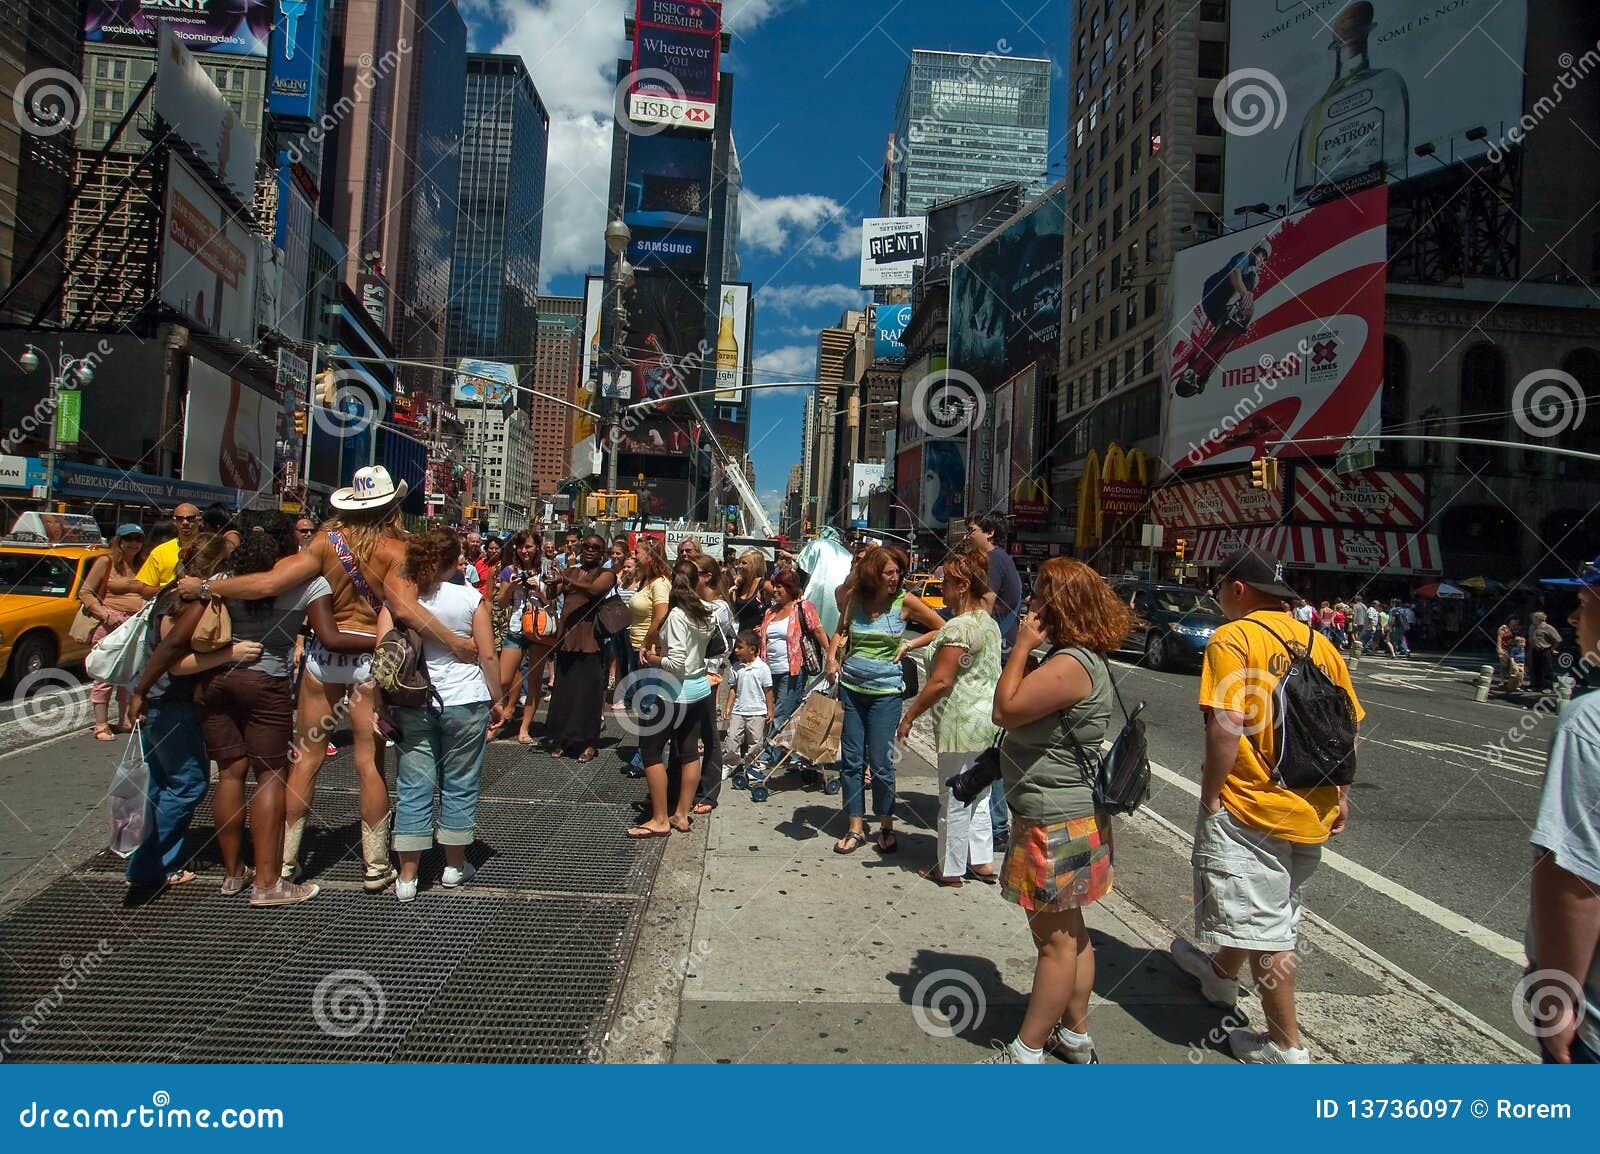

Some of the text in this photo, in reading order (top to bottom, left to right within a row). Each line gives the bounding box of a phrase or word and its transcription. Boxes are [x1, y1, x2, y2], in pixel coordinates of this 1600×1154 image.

[653, 2, 685, 15] HSBC
[653, 13, 703, 29] PREMIER
[1377, 22, 1413, 45] SOME
[1418, 15, 1430, 27] IS
[643, 38, 710, 58] Wherever
[664, 55, 688, 67] you
[634, 101, 683, 119] HSBC
[637, 240, 692, 254] SAMSUNG
[871, 235, 920, 255] RENT
[1310, 363, 1338, 372] GAMES
[68, 474, 109, 488] AMERICAN
[109, 478, 129, 491] EAGLE
[355, 477, 376, 492] NYC
[1103, 485, 1147, 495] McDonald's
[1340, 492, 1386, 504] FRIDAY'S
[706, 534, 723, 544] Inc.
